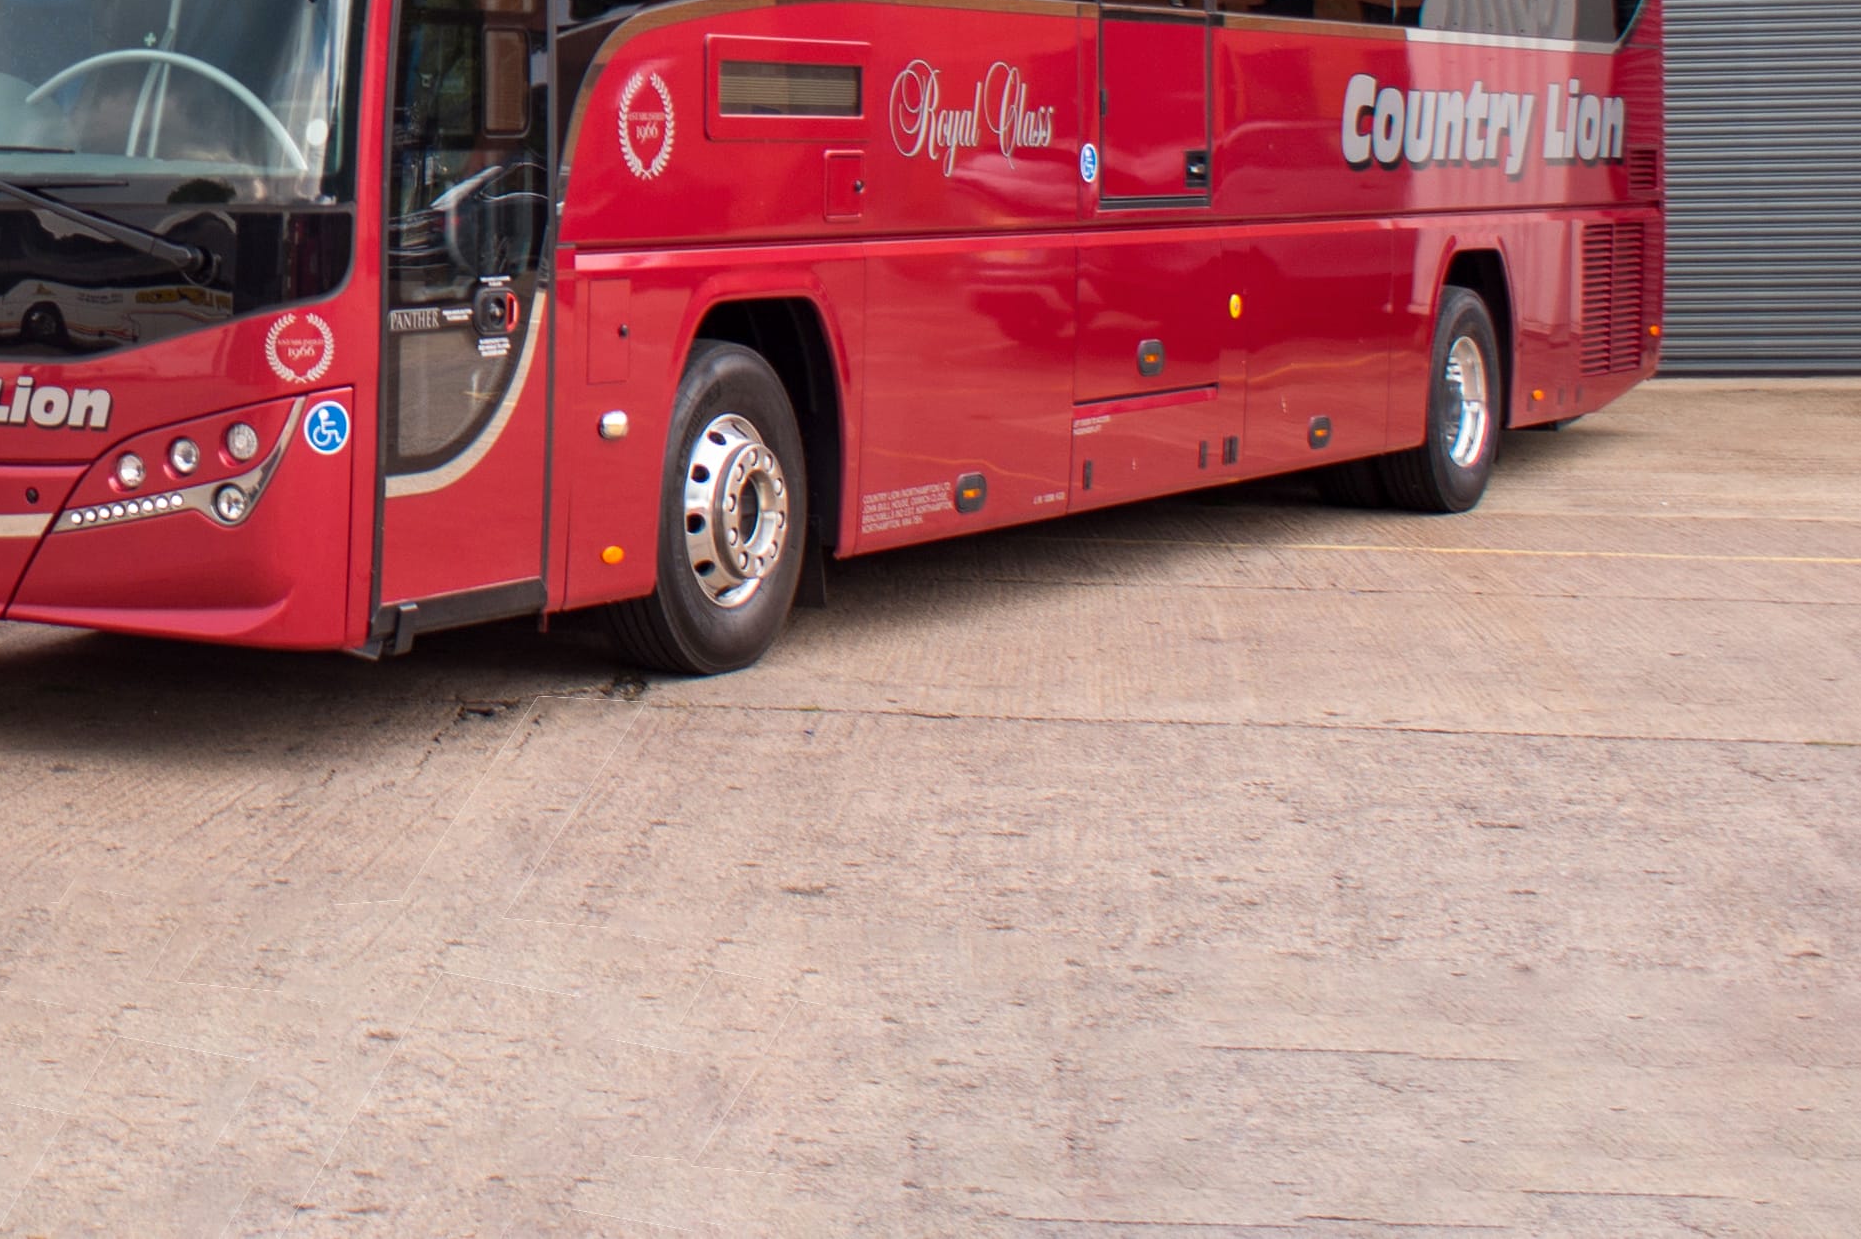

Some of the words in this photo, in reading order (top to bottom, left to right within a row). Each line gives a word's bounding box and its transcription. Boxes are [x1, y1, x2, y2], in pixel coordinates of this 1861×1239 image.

[890, 59, 982, 177] Royal
[984, 62, 1054, 169] Class
[1342, 73, 1535, 177] Country
[1543, 78, 1626, 163] Lion
[636, 121, 659, 144] 1966
[389, 308, 440, 331] PANTHER
[288, 346, 315, 361] 1966
